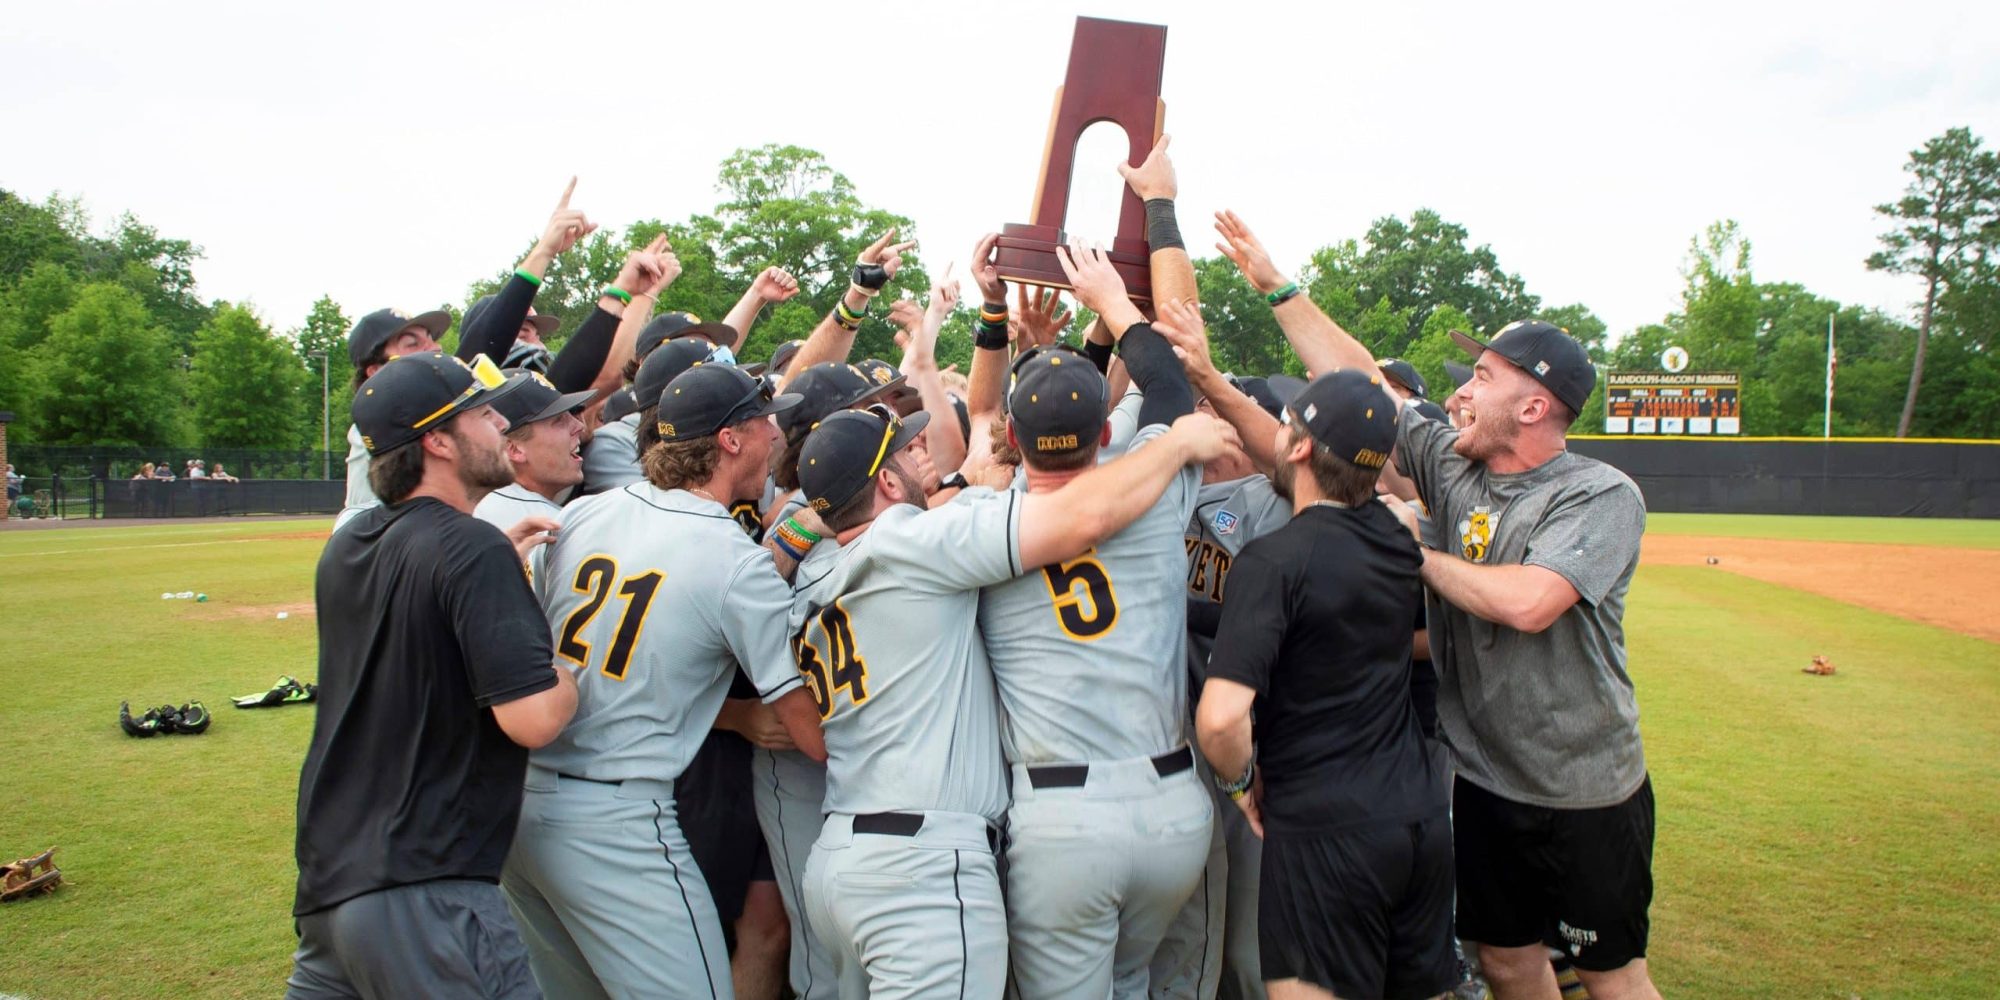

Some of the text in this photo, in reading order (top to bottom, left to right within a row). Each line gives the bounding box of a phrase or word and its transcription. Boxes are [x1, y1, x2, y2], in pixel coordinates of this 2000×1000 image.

[1610, 374, 1738, 385] RANDOLPH-MACON BASEBALL
[557, 552, 668, 682] 21
[1041, 546, 1121, 642] 5
